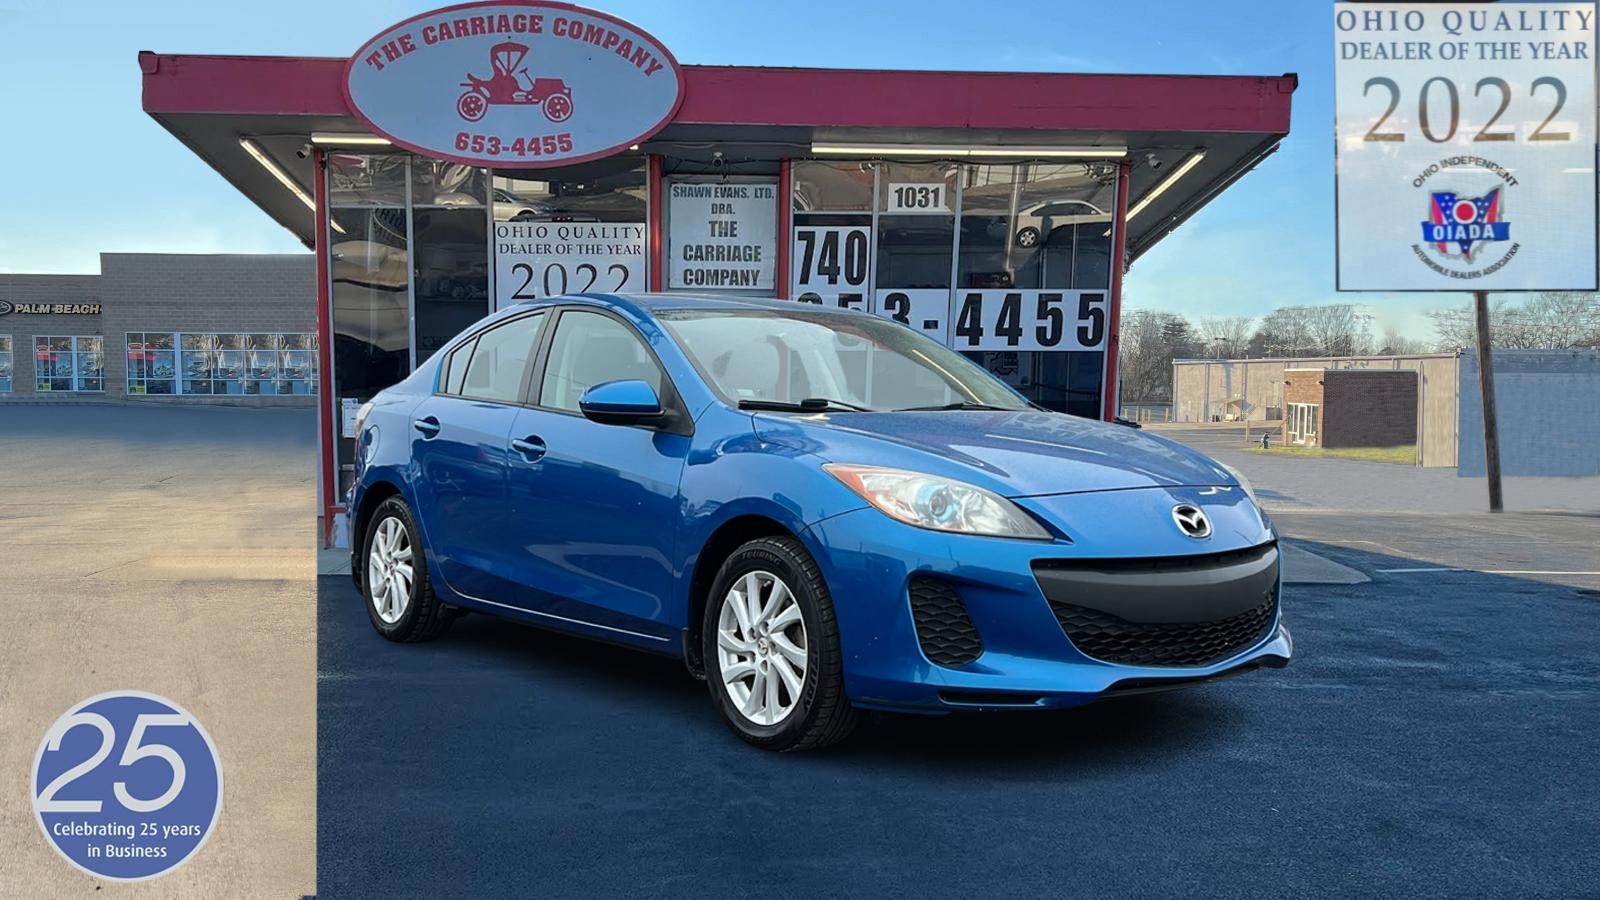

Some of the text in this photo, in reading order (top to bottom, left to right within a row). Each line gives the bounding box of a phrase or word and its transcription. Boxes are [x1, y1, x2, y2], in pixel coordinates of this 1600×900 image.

[1336, 10, 1593, 35] OHIO QUALITY
[365, 14, 664, 77] THE CARRIAGE COMPANY
[1340, 42, 1589, 60] DEALER OF THE YEAR
[1363, 76, 1571, 143] 2022
[454, 132, 573, 156] 653-4455
[1413, 155, 1519, 188] OHIO INDEPENDENT
[672, 186, 712, 199] SHAWN
[754, 186, 775, 199] LTD.
[894, 187, 940, 208] 1031
[711, 203, 735, 215] DBA.
[497, 226, 644, 241] OHIO QUALITY
[708, 221, 737, 237] THE
[1432, 224, 1495, 240] OIADA
[500, 243, 641, 255] DEALER OF THE YEAR
[683, 244, 762, 262] CARRIAGE
[797, 230, 867, 286] 740
[511, 263, 629, 299] 2022
[683, 268, 760, 286] COMPANY
[15, 304, 100, 314] PALM BEACH
